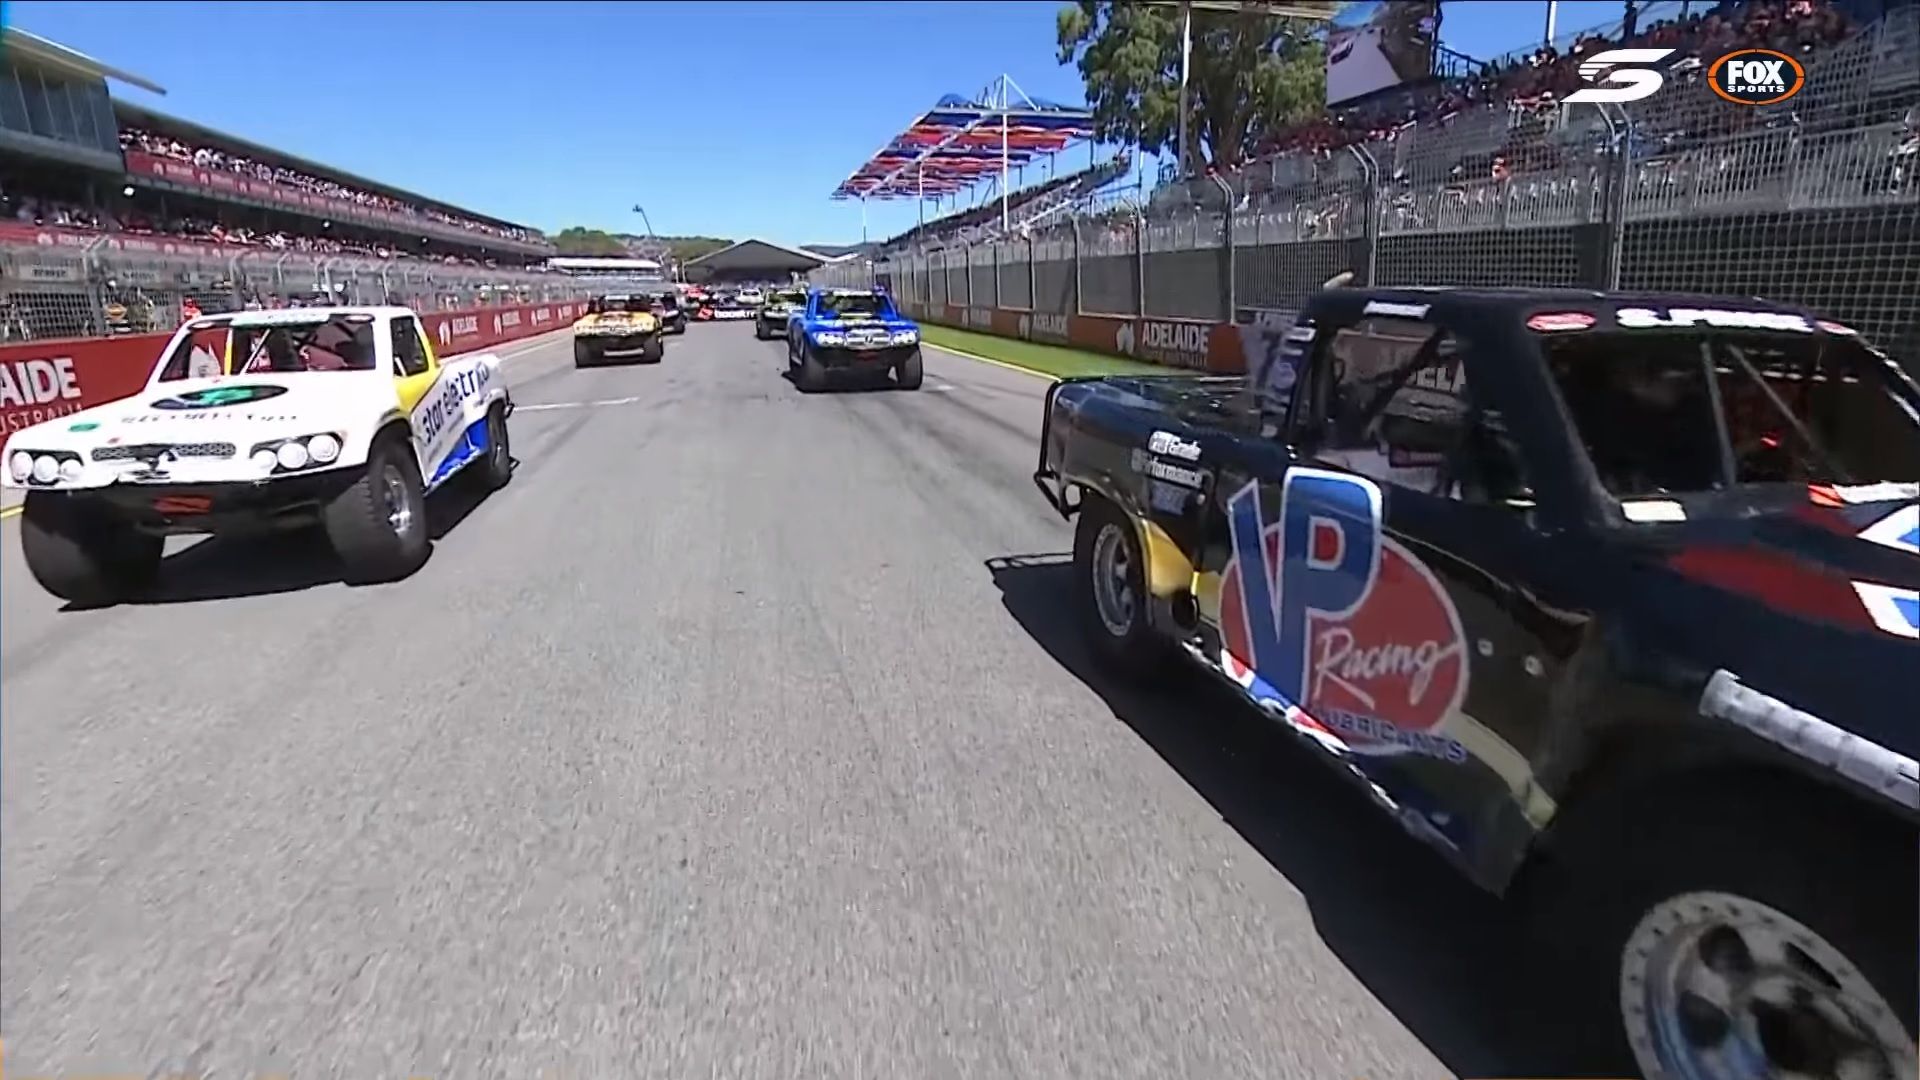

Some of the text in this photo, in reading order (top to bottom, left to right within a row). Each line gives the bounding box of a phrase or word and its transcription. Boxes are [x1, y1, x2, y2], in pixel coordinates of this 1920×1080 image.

[1142, 321, 1211, 353] ADELAIDE
[1227, 466, 1382, 708] VP
[1313, 627, 1460, 710] Racing
